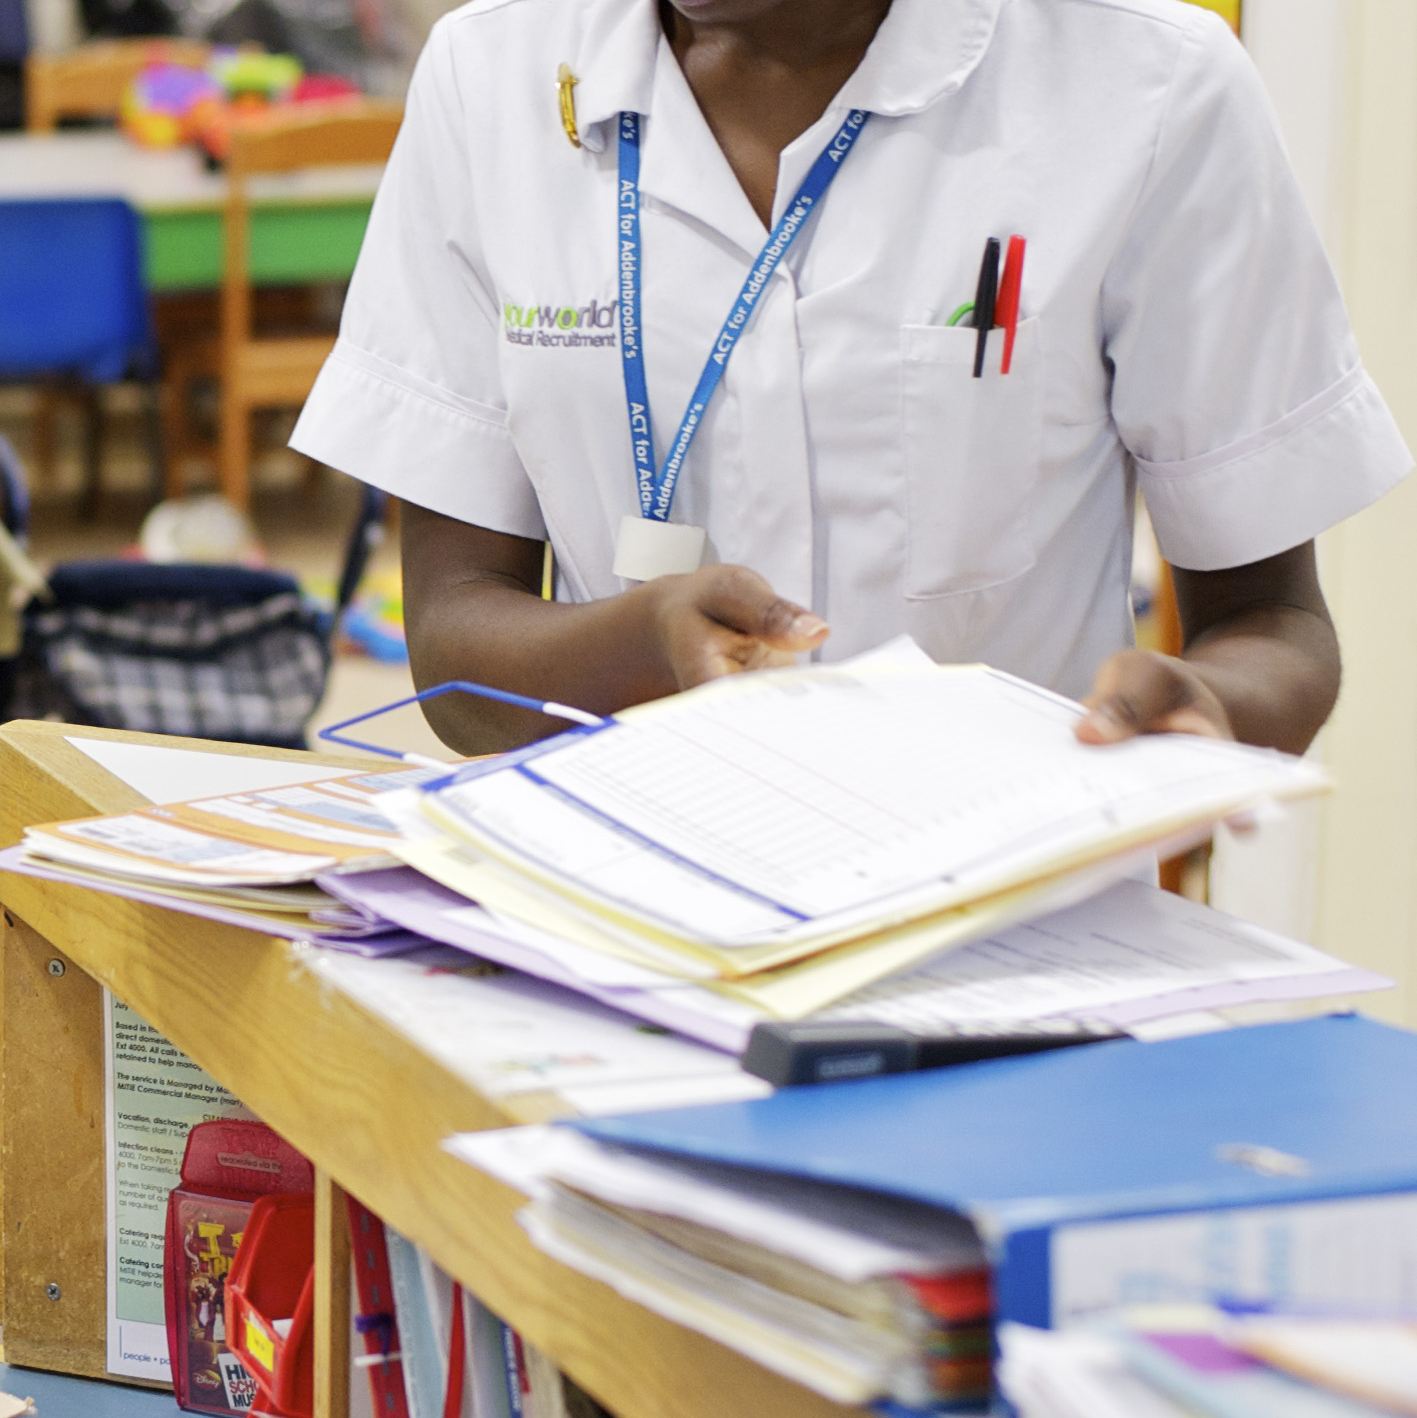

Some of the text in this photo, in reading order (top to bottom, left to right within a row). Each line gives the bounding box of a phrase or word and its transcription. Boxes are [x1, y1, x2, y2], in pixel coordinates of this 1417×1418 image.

[828, 130, 852, 162] ACT
[620, 180, 637, 360] ACT for Addenbrooke's
[712, 195, 814, 365] ACT for Addenbrooke's
[536, 330, 617, 348] Recruitment
[630, 402, 648, 441] ACT
[635, 439, 650, 465] for
[653, 403, 704, 520] Addenbrooke's
[115, 1021, 138, 1031] Based
[139, 1024, 147, 1032] in
[115, 1032, 137, 1042] direct
[149, 1046, 160, 1054] All
[160, 1048, 178, 1057] calls
[115, 1052, 147, 1063] retained
[148, 1056, 156, 1064] to
[157, 1057, 175, 1067] help
[116, 1072, 130, 1081] The
[131, 1074, 158, 1085] service
[166, 1079, 204, 1092] Managed
[204, 1084, 215, 1094] by
[137, 1085, 184, 1098] Commercial
[184, 1092, 219, 1104] Manager
[117, 1121, 150, 1133] Domestic
[117, 1141, 149, 1152] Infection
[150, 1146, 174, 1155] cleans
[127, 1161, 139, 1170] the
[140, 1163, 174, 1175] Domestic
[118, 1190, 146, 1199] number
[147, 1193, 155, 1201] of
[118, 1227, 149, 1240] Catering
[119, 1256, 150, 1269] Catering
[119, 1276, 153, 1288] manager
[123, 1351, 152, 1363] people
